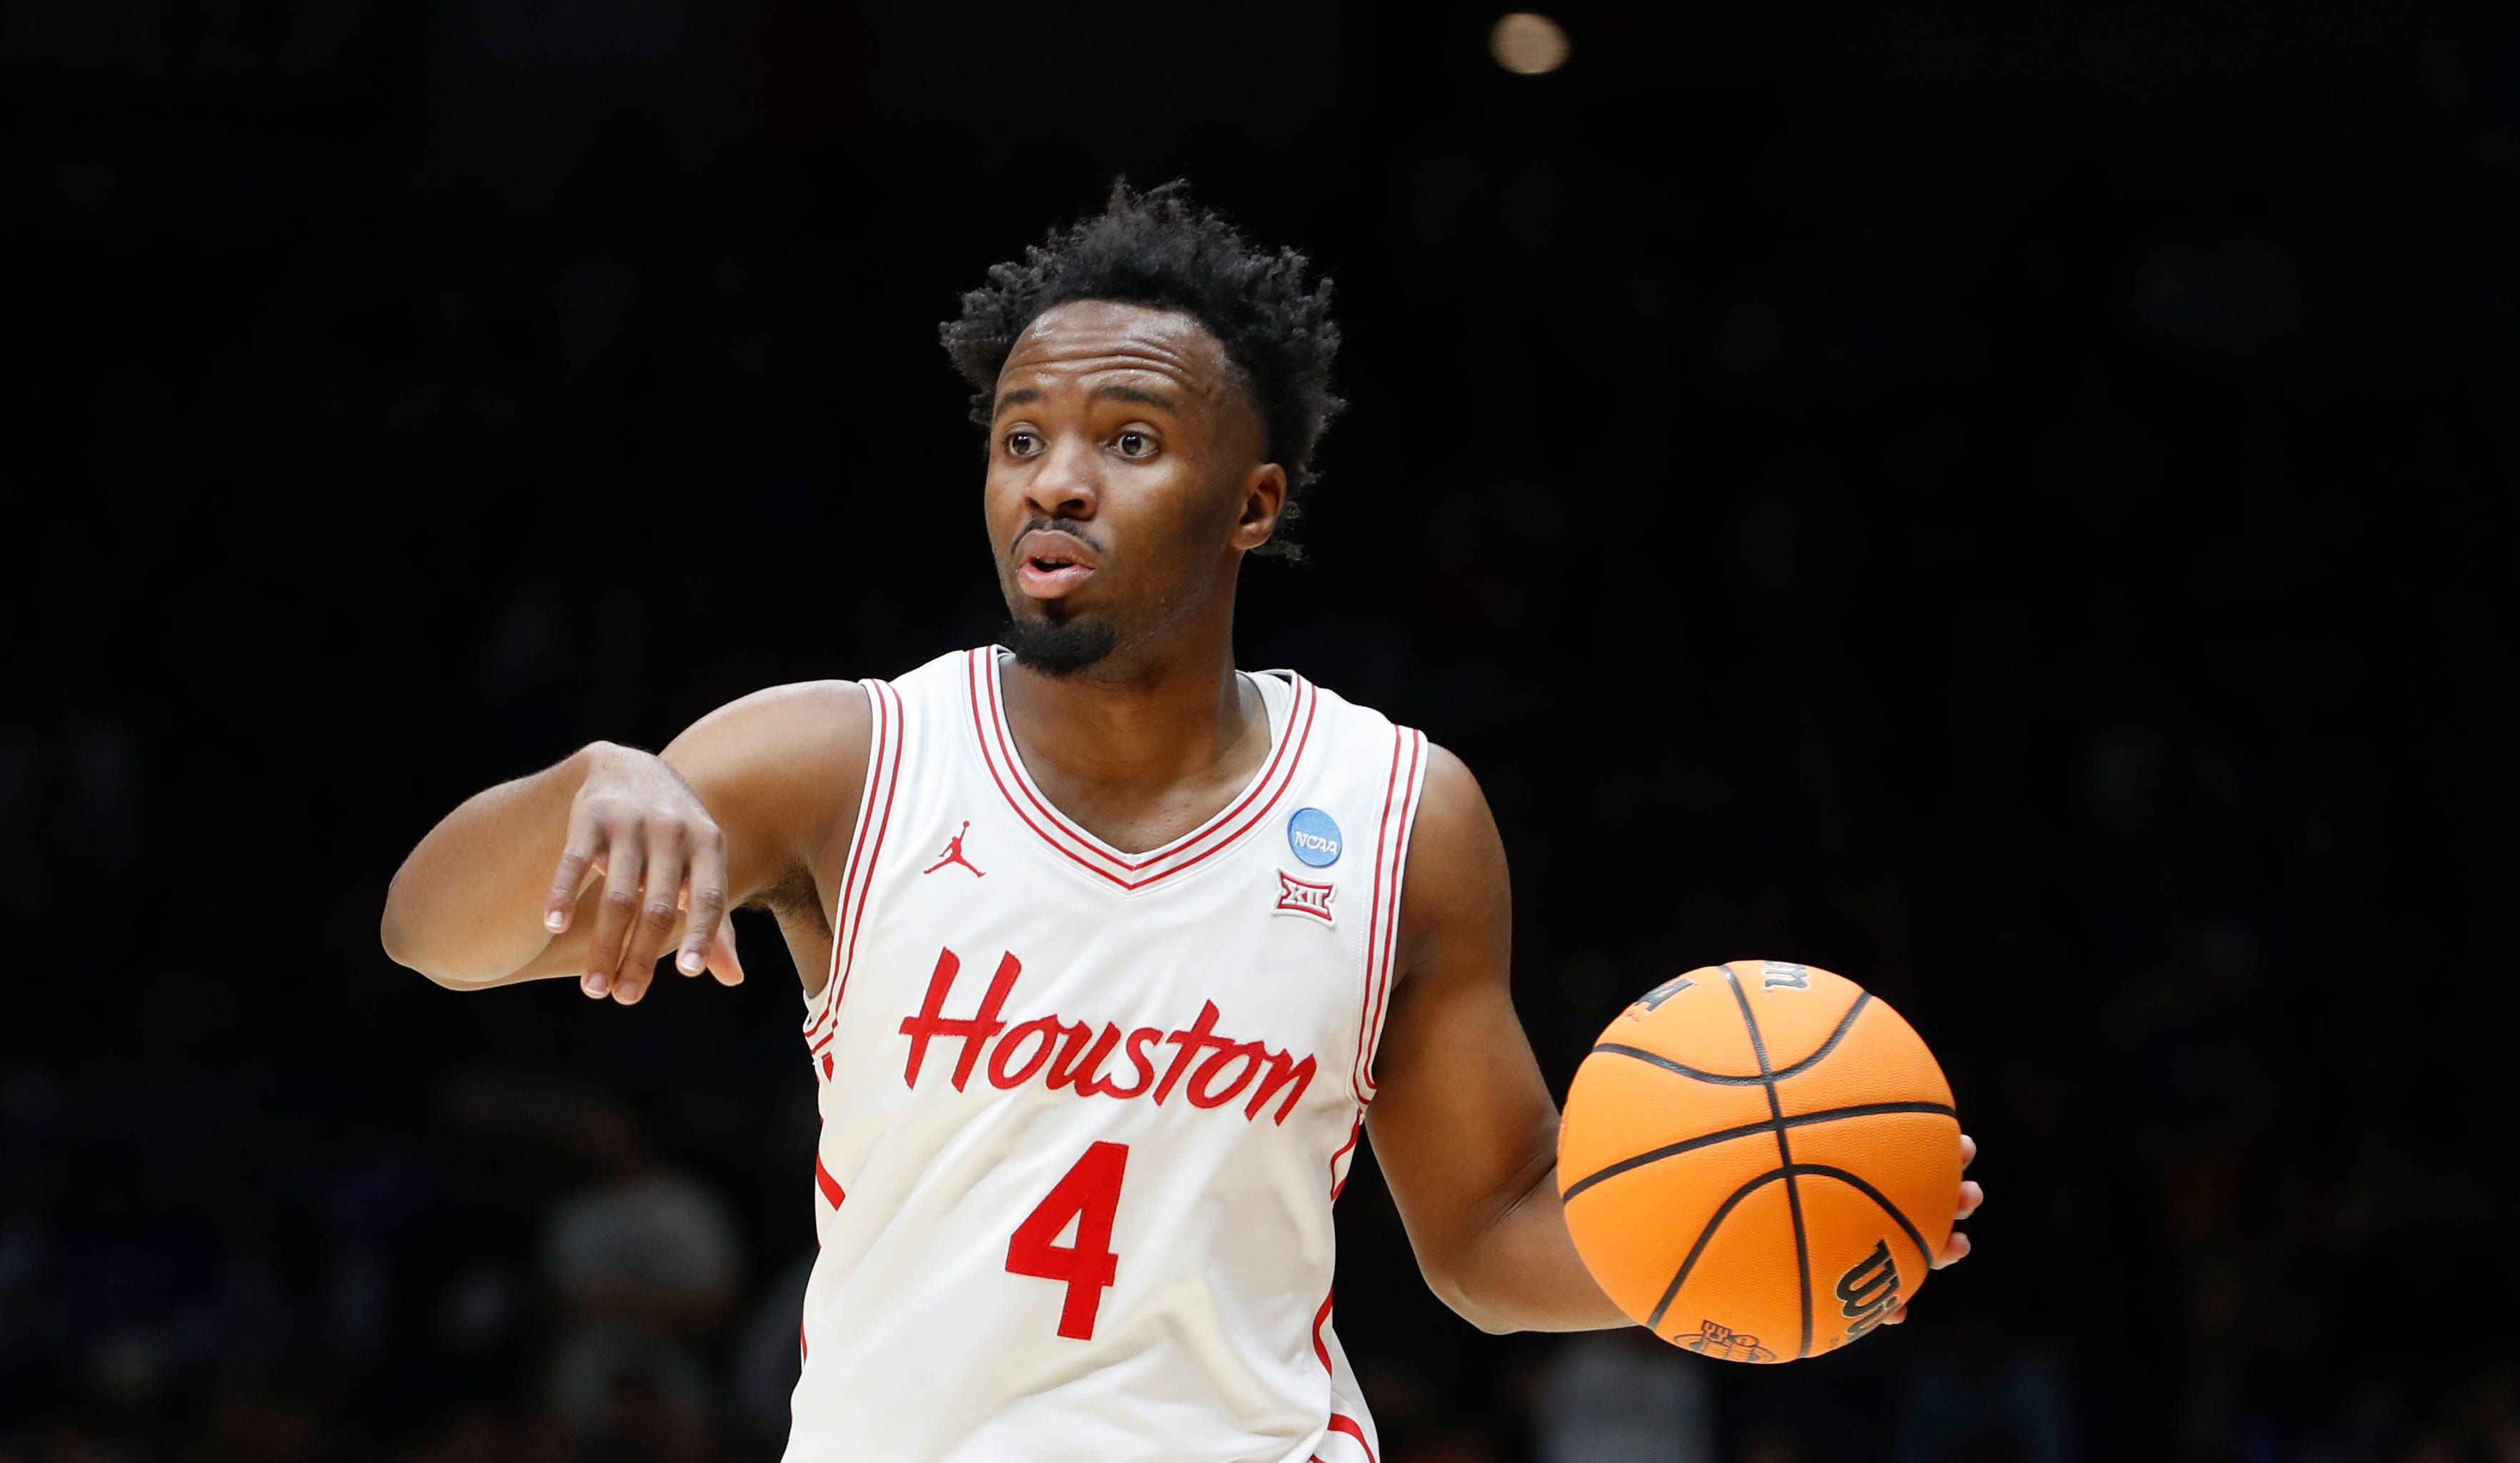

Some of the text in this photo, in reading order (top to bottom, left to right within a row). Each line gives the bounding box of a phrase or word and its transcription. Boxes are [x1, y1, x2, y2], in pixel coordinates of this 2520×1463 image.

[1294, 831, 1339, 856] NCAA
[899, 946, 1317, 1126] Houston
[1005, 1140, 1129, 1341] 4
